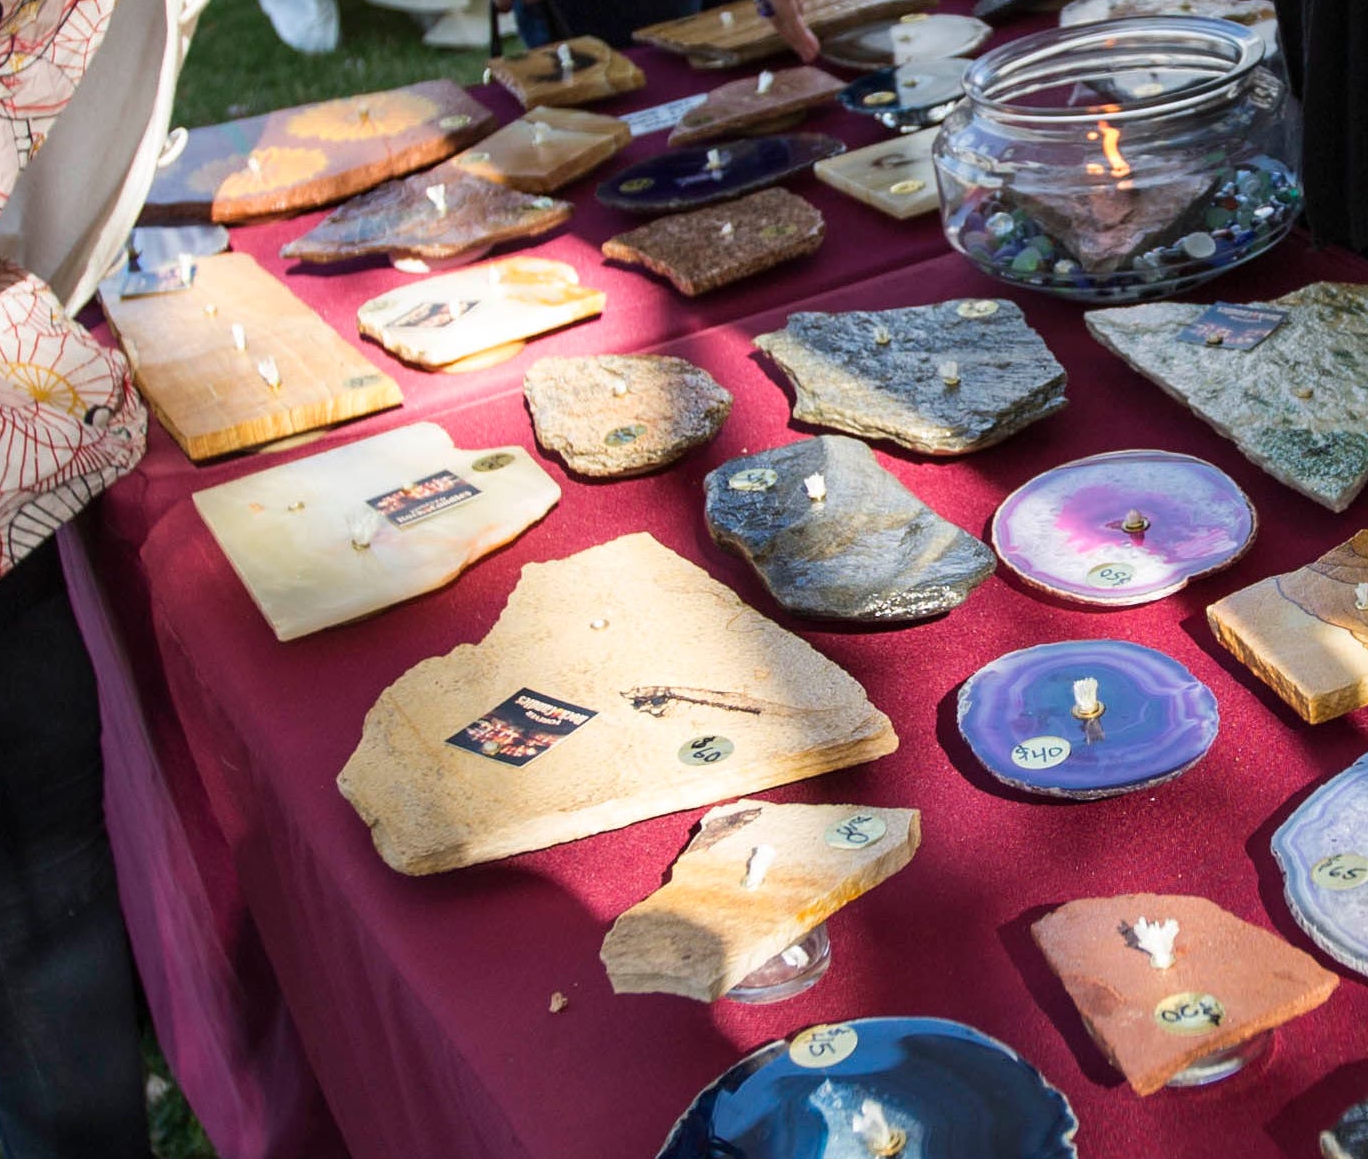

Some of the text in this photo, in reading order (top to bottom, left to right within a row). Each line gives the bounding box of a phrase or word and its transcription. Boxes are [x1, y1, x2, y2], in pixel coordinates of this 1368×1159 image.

[558, 708, 590, 726] Rock
[691, 736, 721, 762] $60
[1015, 745, 1063, 763] $40
[1319, 854, 1368, 881] $65
